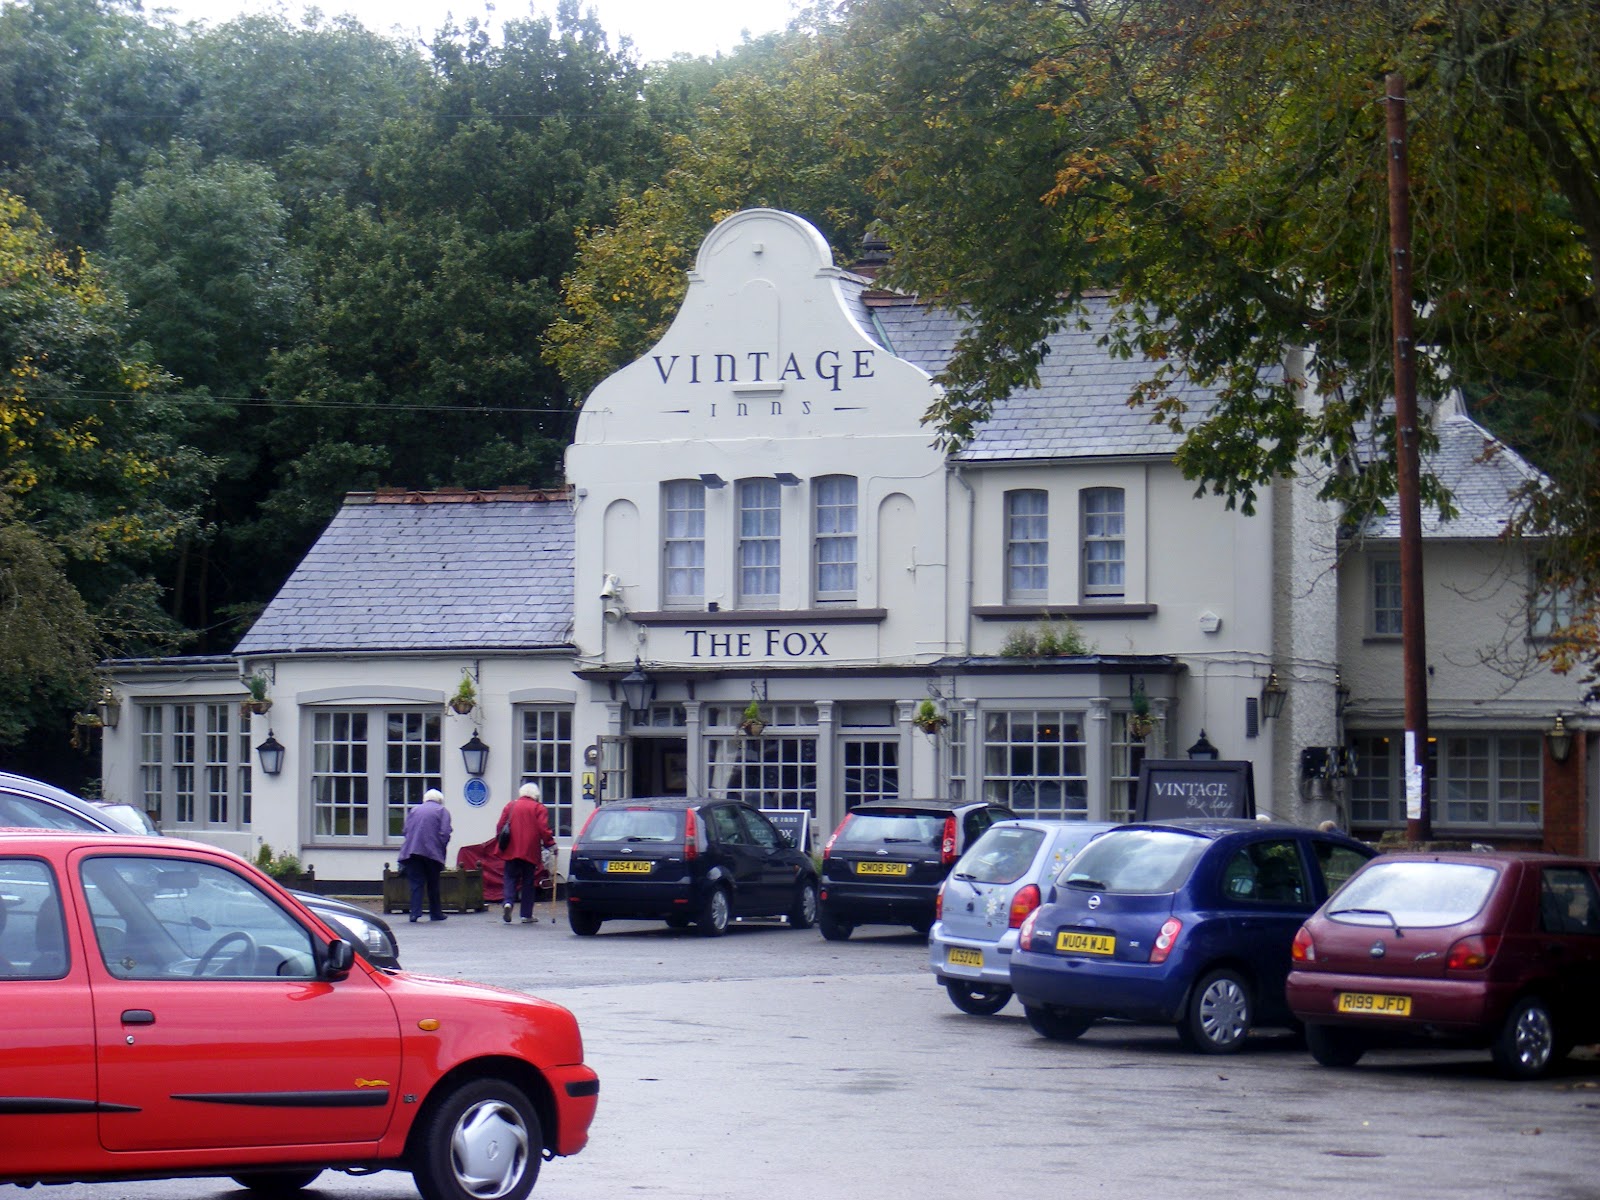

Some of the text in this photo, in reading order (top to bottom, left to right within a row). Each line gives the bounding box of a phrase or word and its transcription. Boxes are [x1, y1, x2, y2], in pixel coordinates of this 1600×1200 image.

[652, 350, 875, 391] VINTAGE
[684, 629, 830, 657] THE FOX
[1154, 782, 1228, 796] VINTAGE
[885, 864, 903, 873] SPU
[1062, 934, 1110, 951] WU04 WJL
[1344, 994, 1406, 1011] R199 JFD
